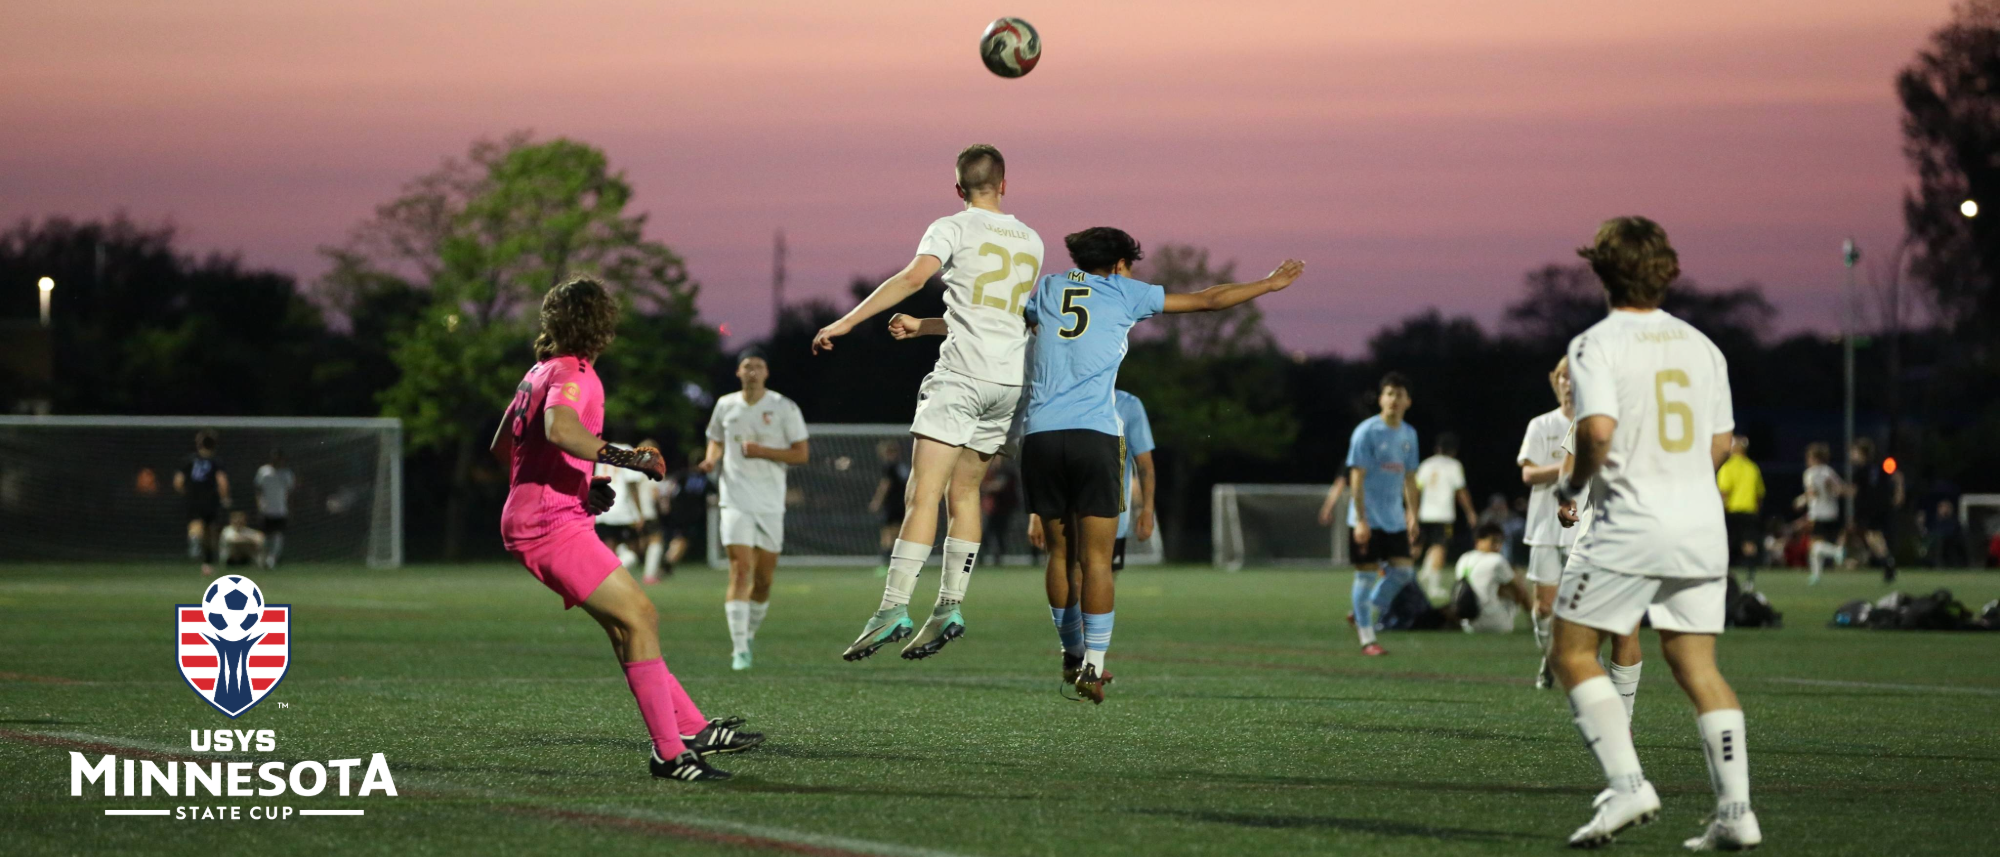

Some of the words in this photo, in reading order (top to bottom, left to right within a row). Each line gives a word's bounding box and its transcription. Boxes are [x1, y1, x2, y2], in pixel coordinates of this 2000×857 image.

[972, 242, 1039, 316] 22
[1057, 287, 1092, 339] 5
[1655, 369, 1694, 452] 6
